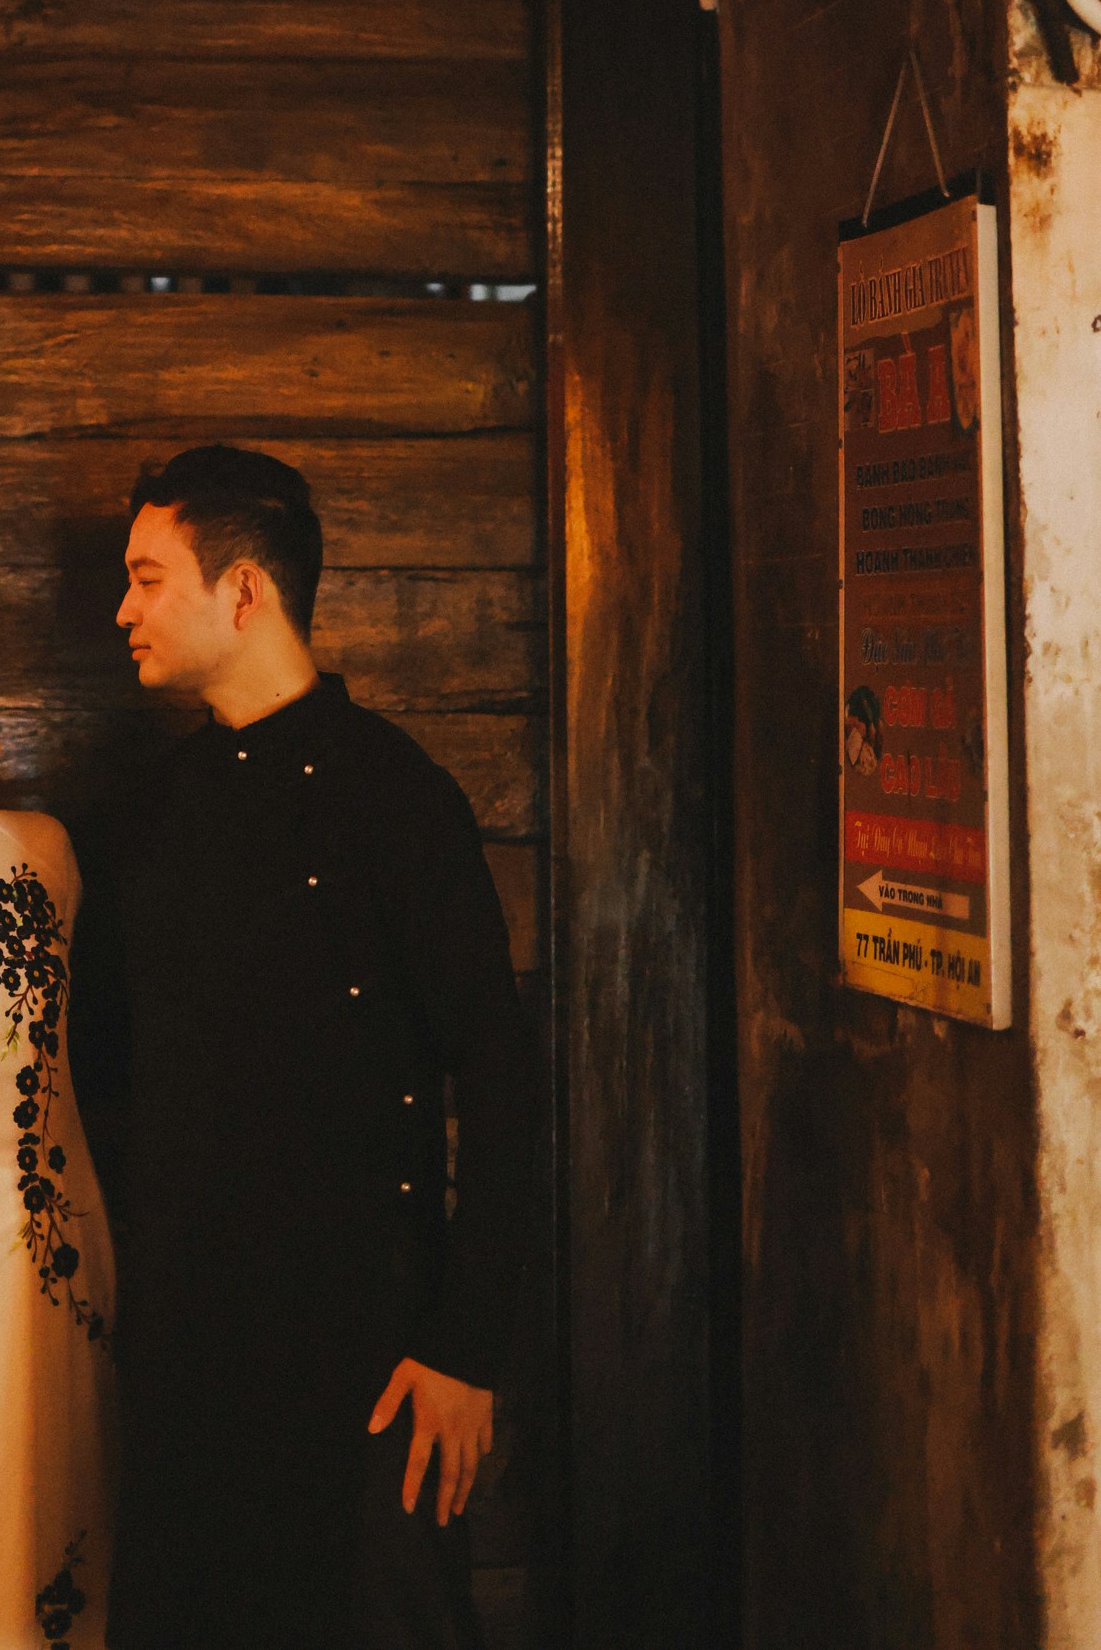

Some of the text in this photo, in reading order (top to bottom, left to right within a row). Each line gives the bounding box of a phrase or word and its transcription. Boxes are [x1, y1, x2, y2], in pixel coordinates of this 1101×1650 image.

[898, 888, 925, 906] TRONG
[856, 932, 869, 958] 77
[902, 938, 923, 972] PHÚ
